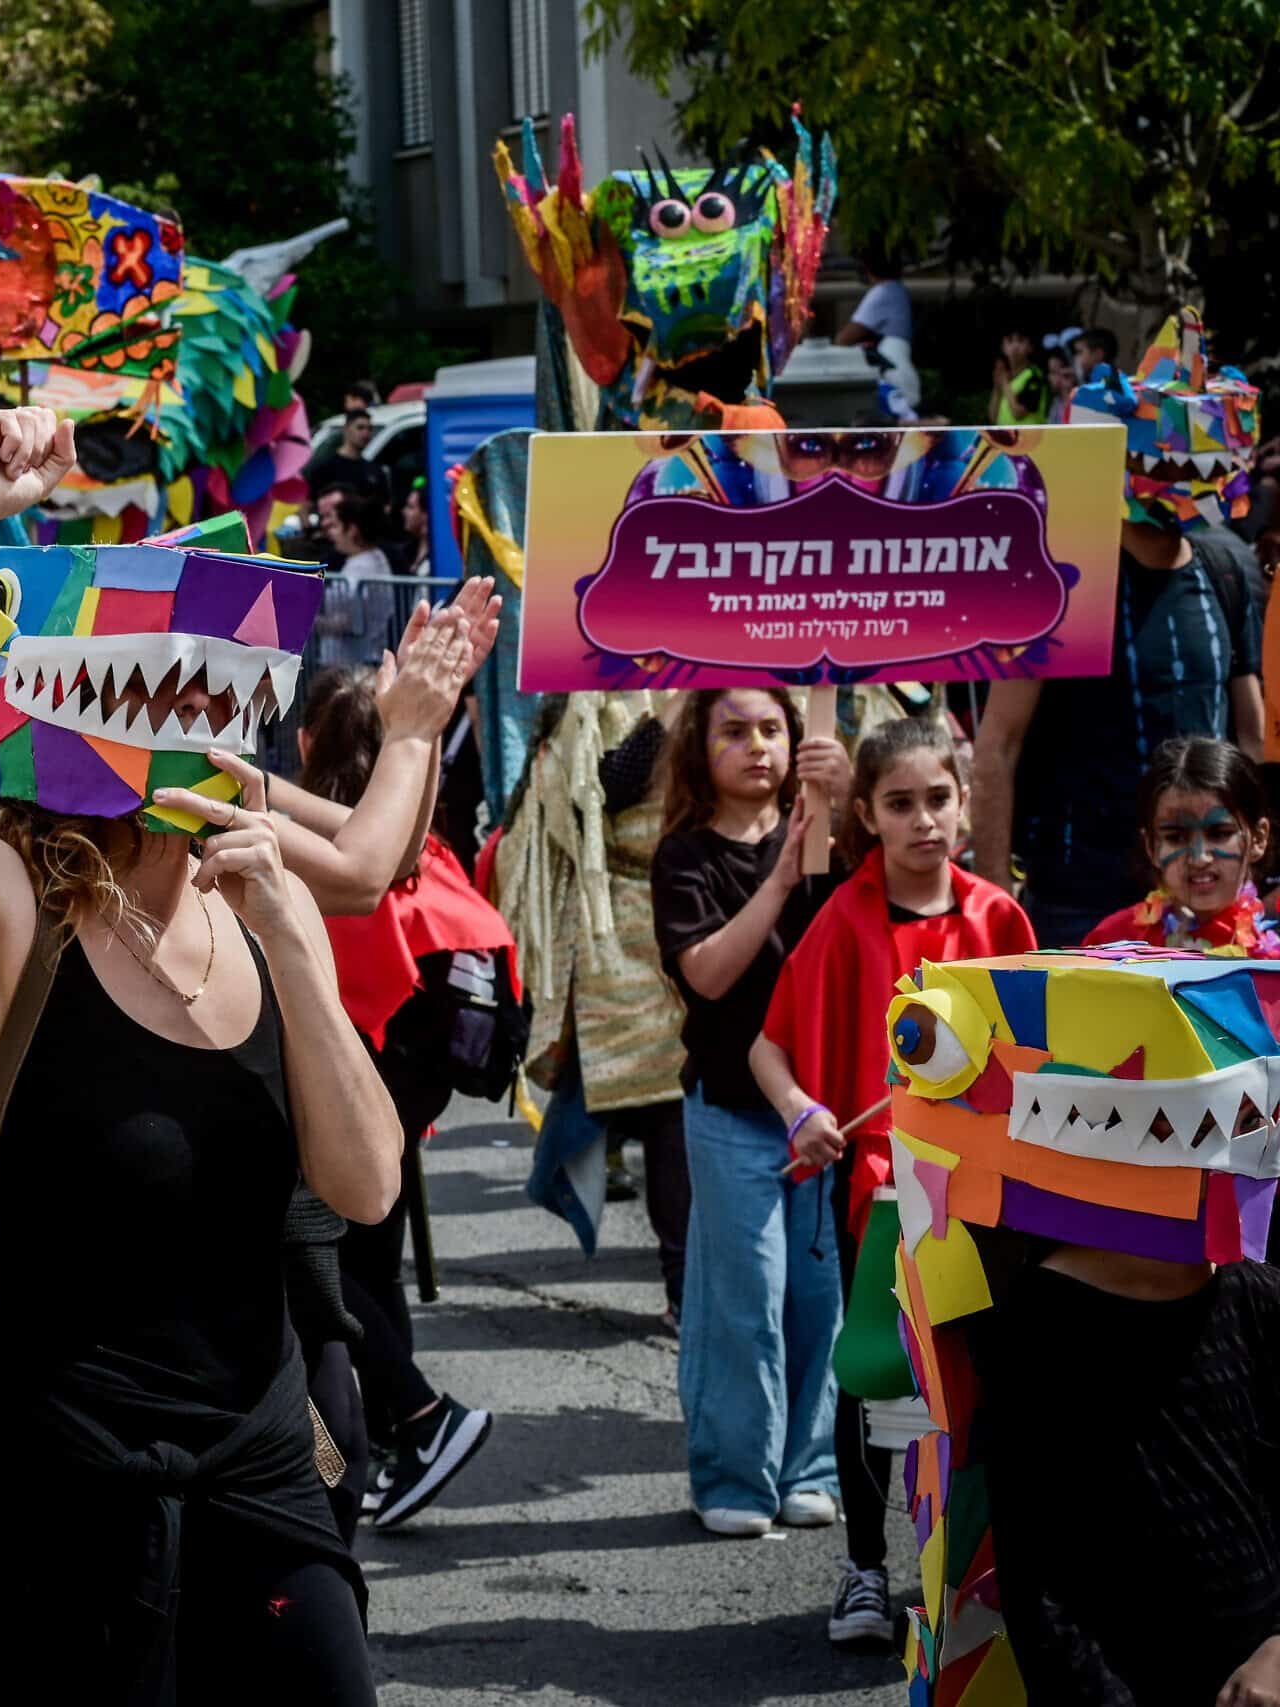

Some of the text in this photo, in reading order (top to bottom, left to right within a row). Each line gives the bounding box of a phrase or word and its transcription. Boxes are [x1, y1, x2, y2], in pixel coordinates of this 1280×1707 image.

[645, 535, 1012, 585] אומנות הקרנבל
[708, 589, 946, 612] מרכז קהילתי נאות רחל
[744, 618, 909, 640] רשת קהילה ופנאי
